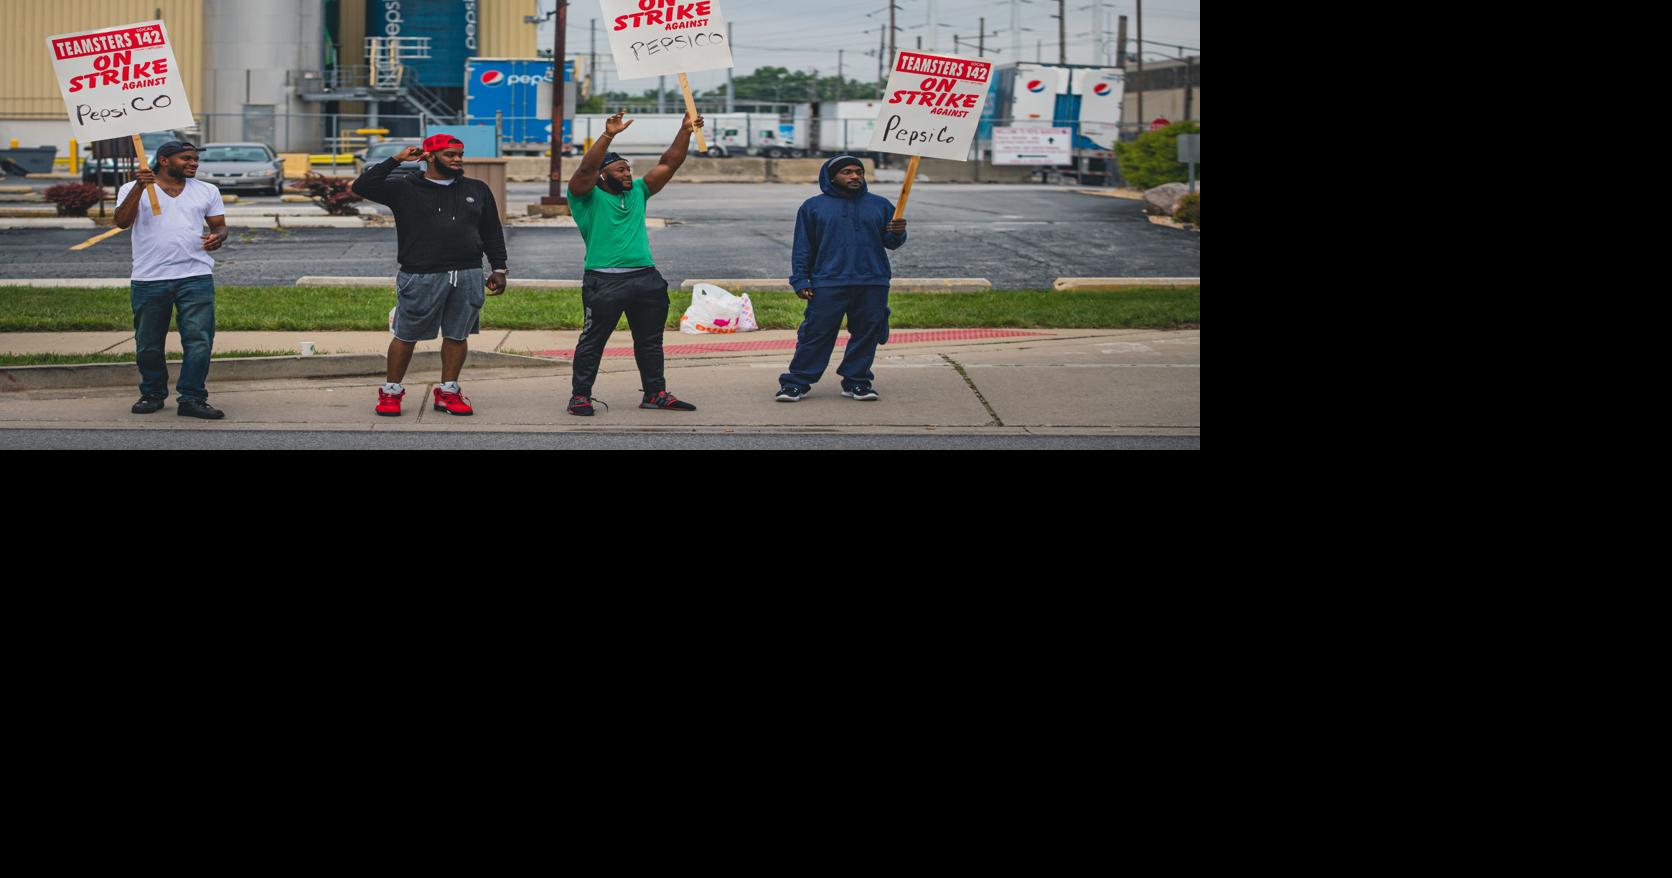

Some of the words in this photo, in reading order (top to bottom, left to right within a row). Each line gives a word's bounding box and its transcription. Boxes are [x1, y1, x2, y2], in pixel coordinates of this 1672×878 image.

[613, 0, 711, 32] STRIKE
[664, 18, 709, 31] AGAINST
[56, 32, 133, 57] TEAMSTERS
[134, 30, 162, 46] 142
[630, 31, 724, 63] PEPSICO
[93, 50, 132, 71] ON
[901, 55, 965, 77] TEAMSTERS
[965, 66, 988, 80] 142
[68, 58, 168, 93] STRIKE
[122, 77, 167, 91] AGAINST
[920, 77, 957, 92] ON
[888, 90, 980, 109] STRIKE
[930, 107, 970, 118] AGAINST
